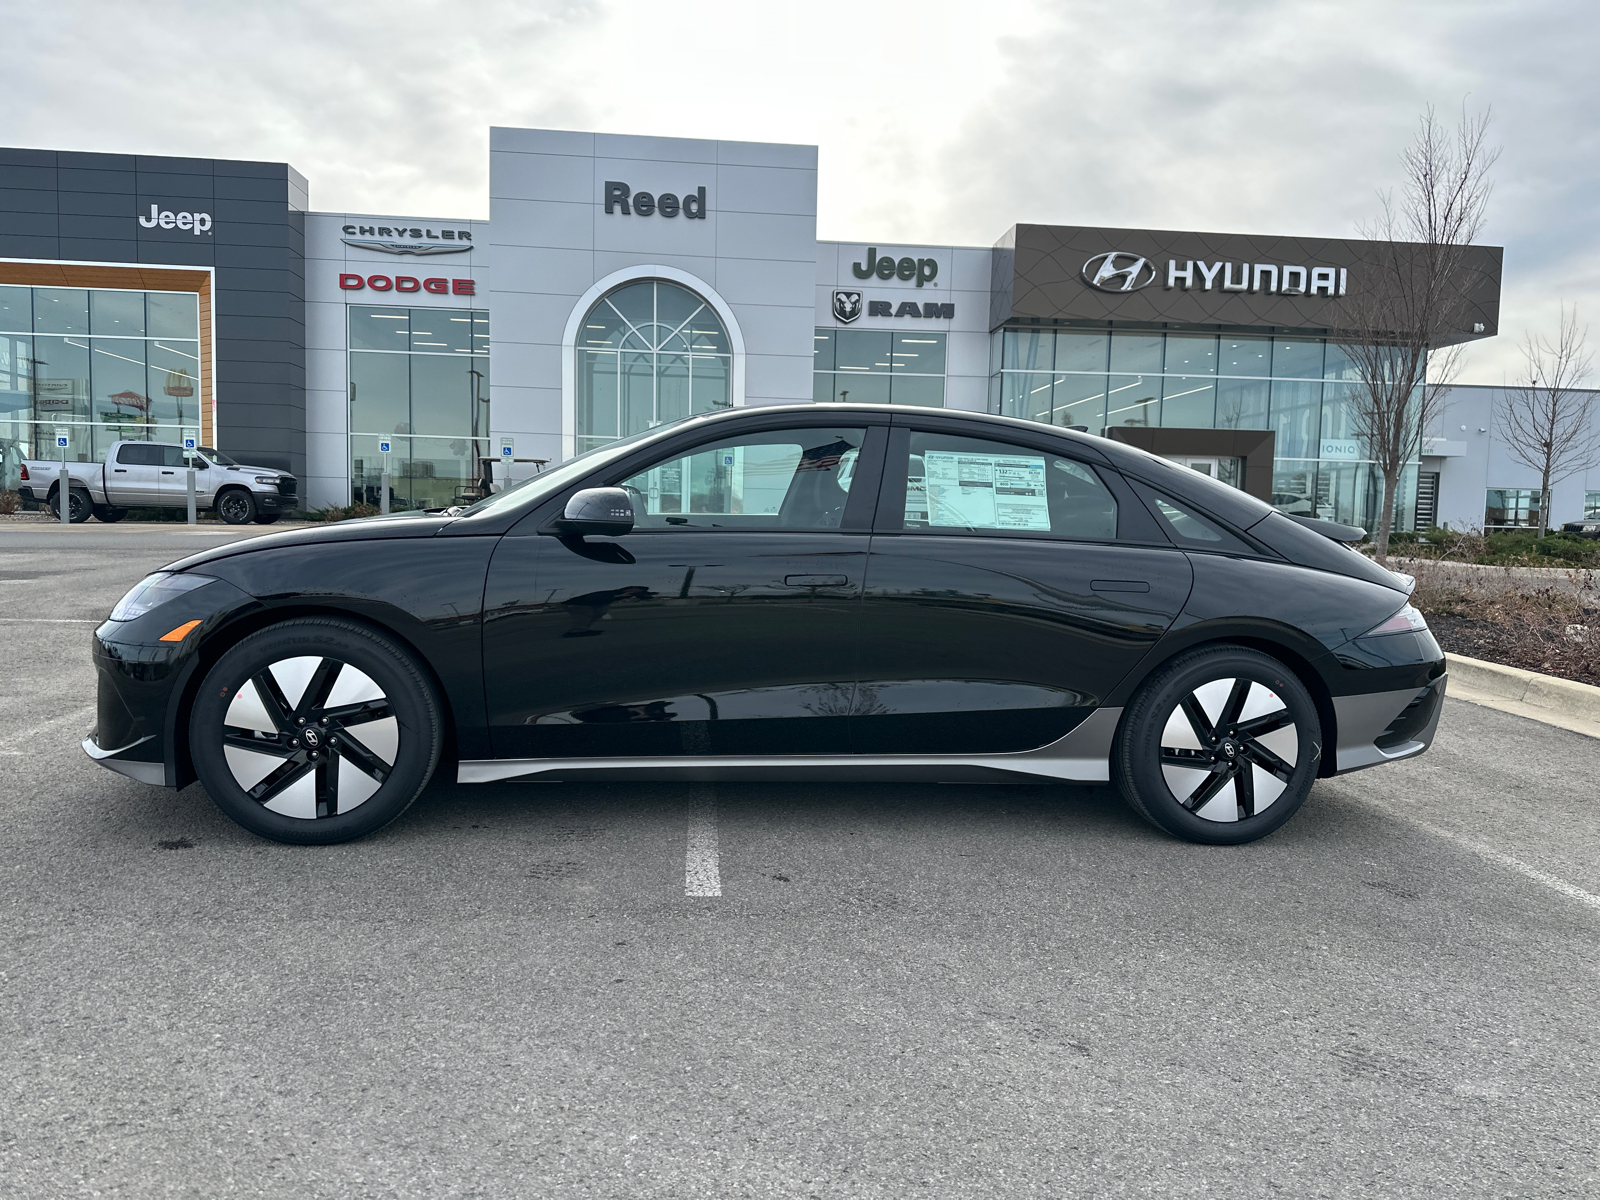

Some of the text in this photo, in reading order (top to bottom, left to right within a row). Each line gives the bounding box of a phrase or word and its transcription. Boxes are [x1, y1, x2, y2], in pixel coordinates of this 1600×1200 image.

[604, 180, 707, 220] Reed
[138, 204, 213, 236] Jeep
[341, 224, 473, 242] CHRYSLER
[852, 246, 938, 288] Jeep
[1166, 258, 1348, 298] HYUNDAI
[338, 272, 476, 297] DODGE
[868, 299, 956, 320] RAM
[1321, 444, 1356, 455] IONIQ
